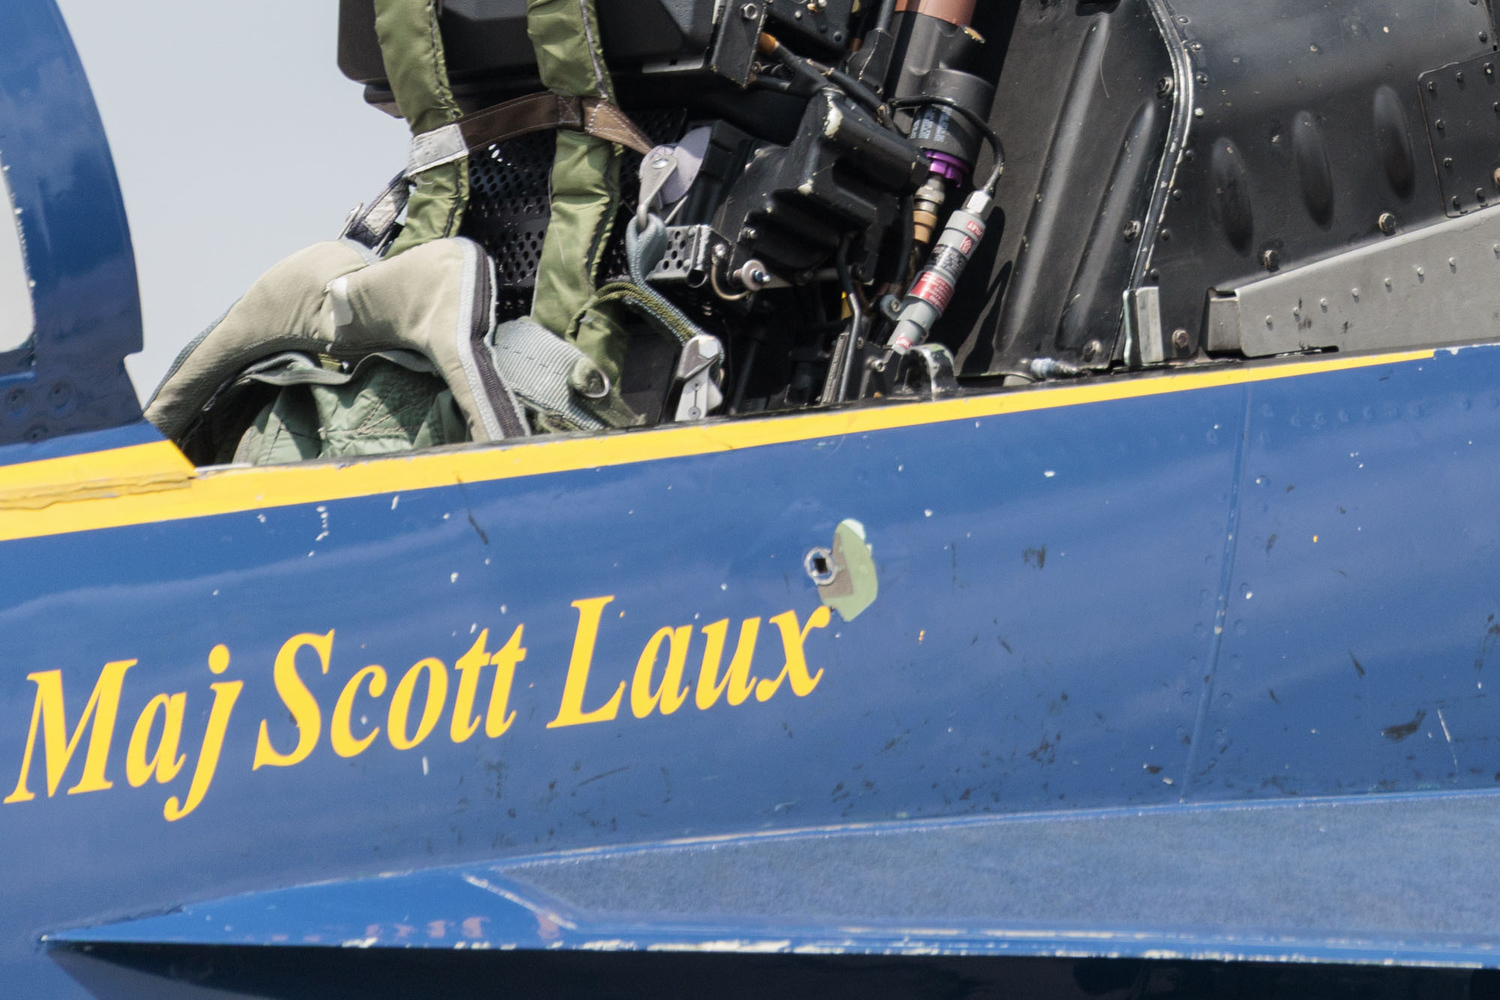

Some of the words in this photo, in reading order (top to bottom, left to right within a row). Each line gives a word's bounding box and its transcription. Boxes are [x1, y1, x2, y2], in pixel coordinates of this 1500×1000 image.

[4, 644, 244, 822] Maj
[252, 622, 527, 771] Scott
[547, 595, 831, 731] Laux
